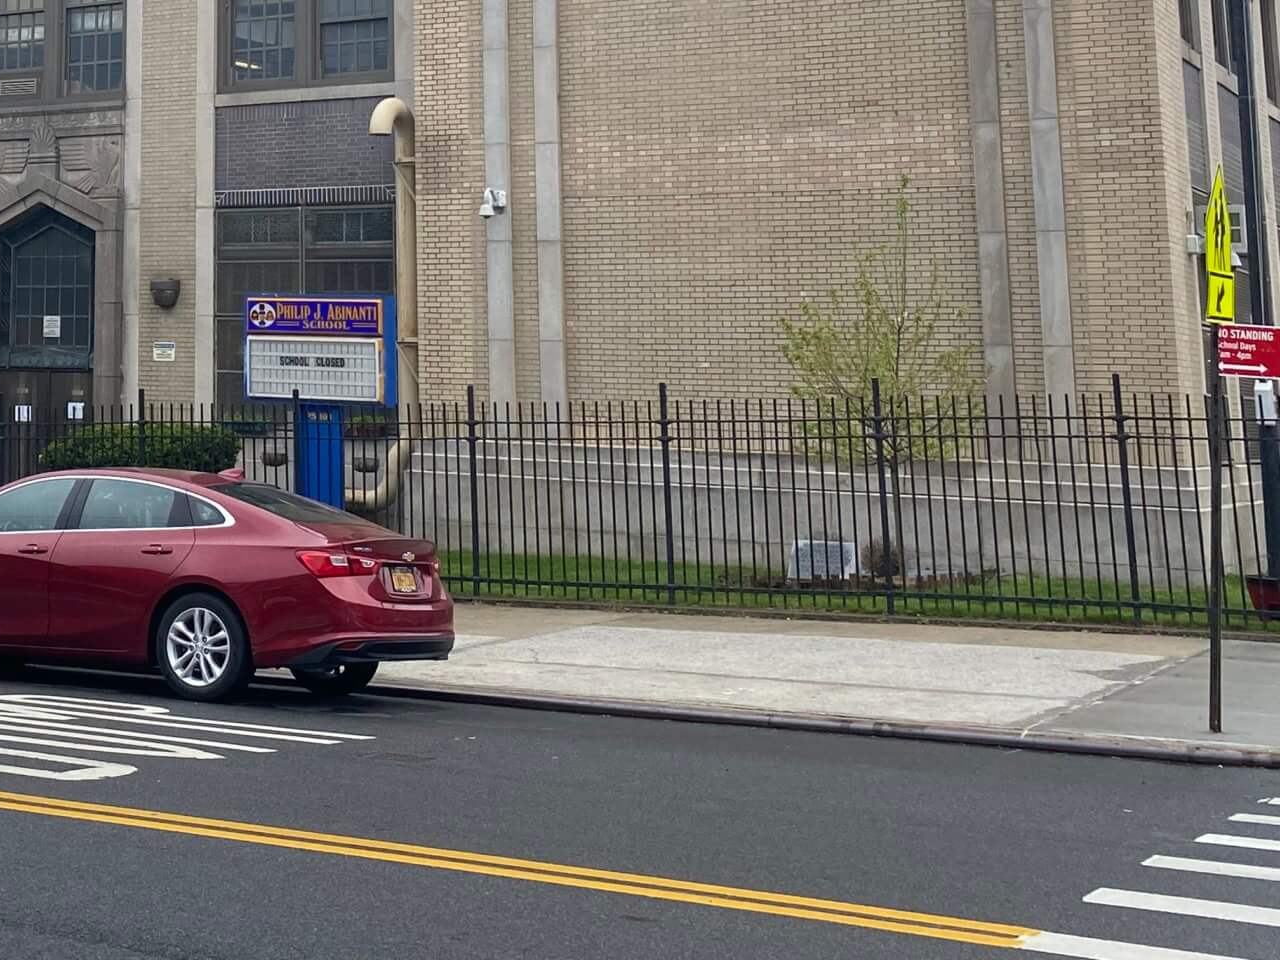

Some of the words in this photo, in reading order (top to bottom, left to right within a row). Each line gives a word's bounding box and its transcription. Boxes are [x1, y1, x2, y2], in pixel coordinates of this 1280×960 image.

[276, 303, 311, 321] PHILIP
[313, 304, 324, 321] J.
[327, 304, 377, 321] ABINANTI
[302, 320, 350, 330] SCHOOL
[1230, 329, 1275, 342] STANDING
[279, 356, 309, 367] SCHOOL
[315, 356, 345, 368] CLOSED
